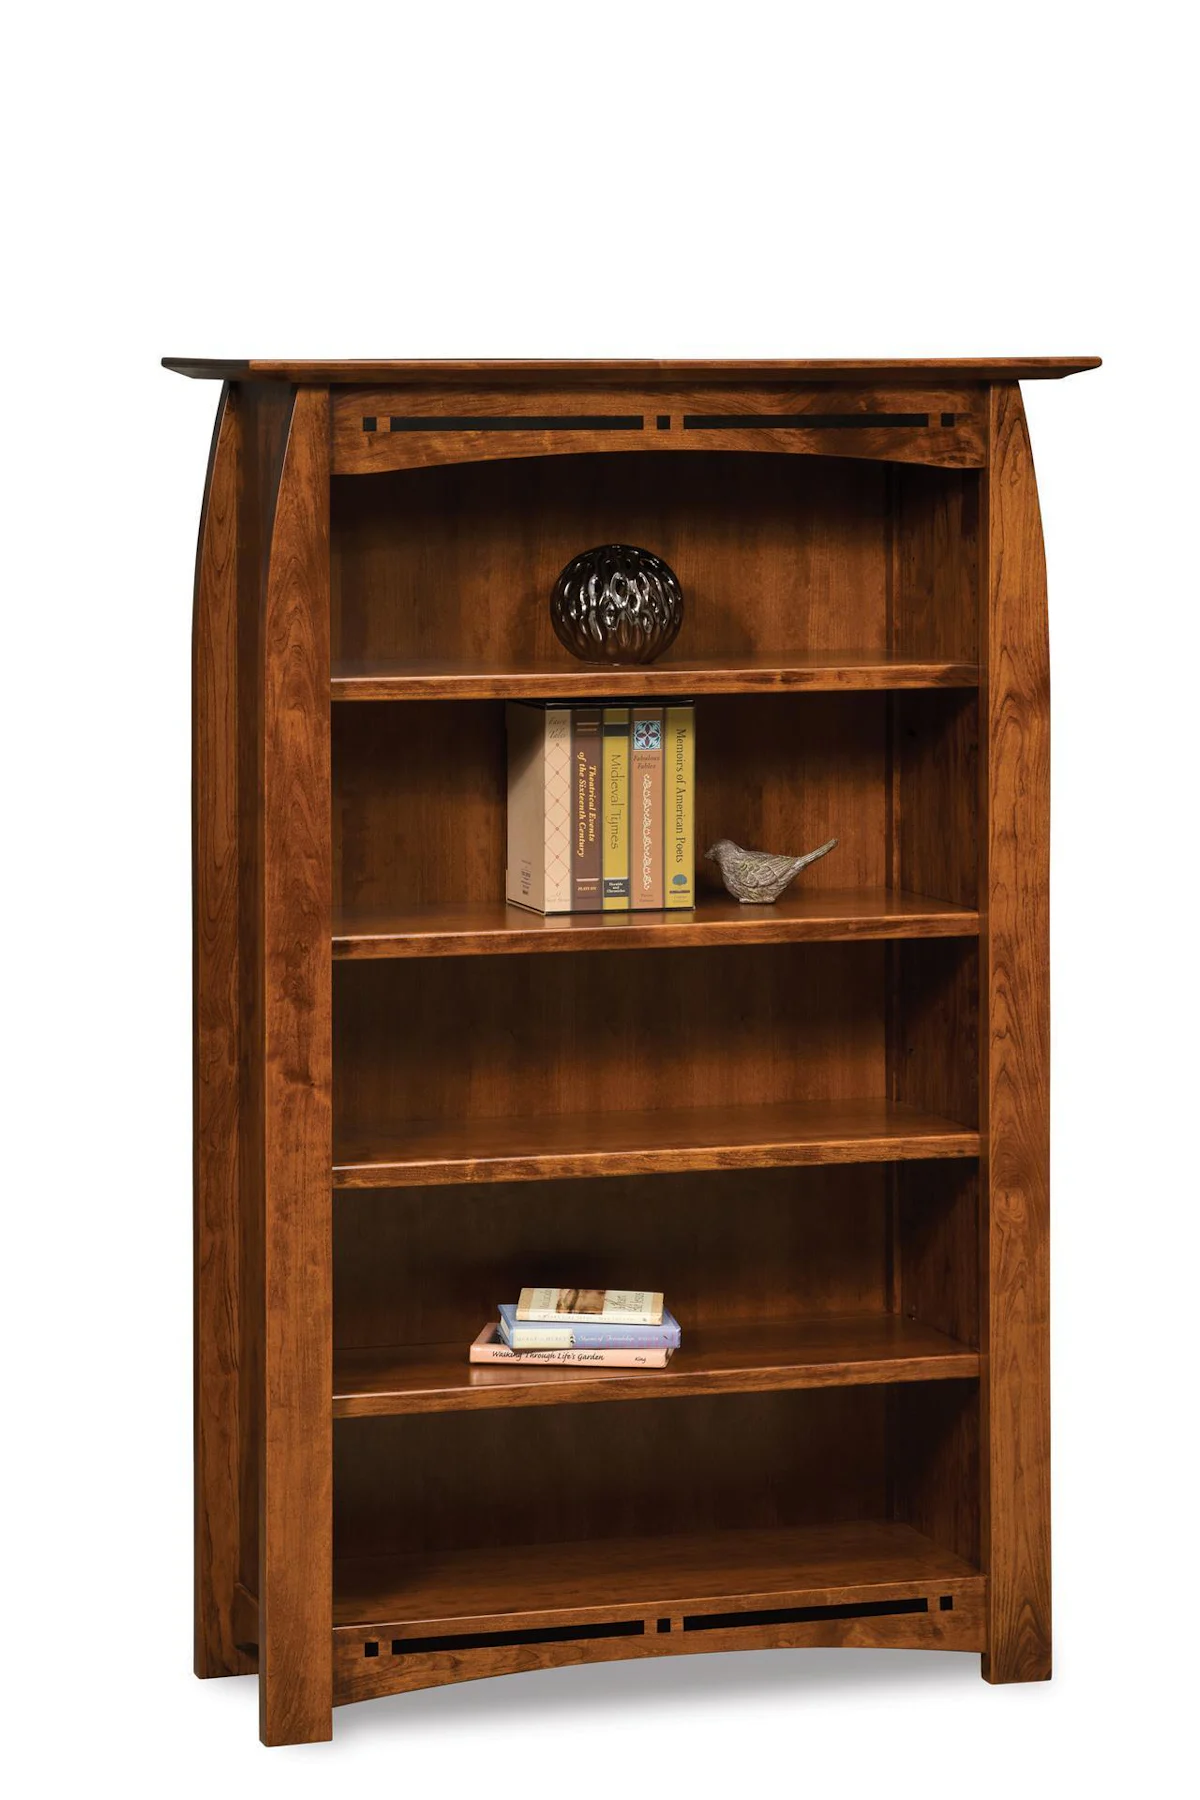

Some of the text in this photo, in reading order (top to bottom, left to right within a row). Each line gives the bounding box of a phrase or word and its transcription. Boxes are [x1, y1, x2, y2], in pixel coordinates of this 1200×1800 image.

[577, 751, 587, 858] of the Sixteenth Century
[588, 765, 597, 842] Theatrical Events
[675, 728, 686, 863] Memoirs of American Poets
[492, 1350, 604, 1363] Walking Through Life's Garden
[634, 1356, 646, 1364] King
